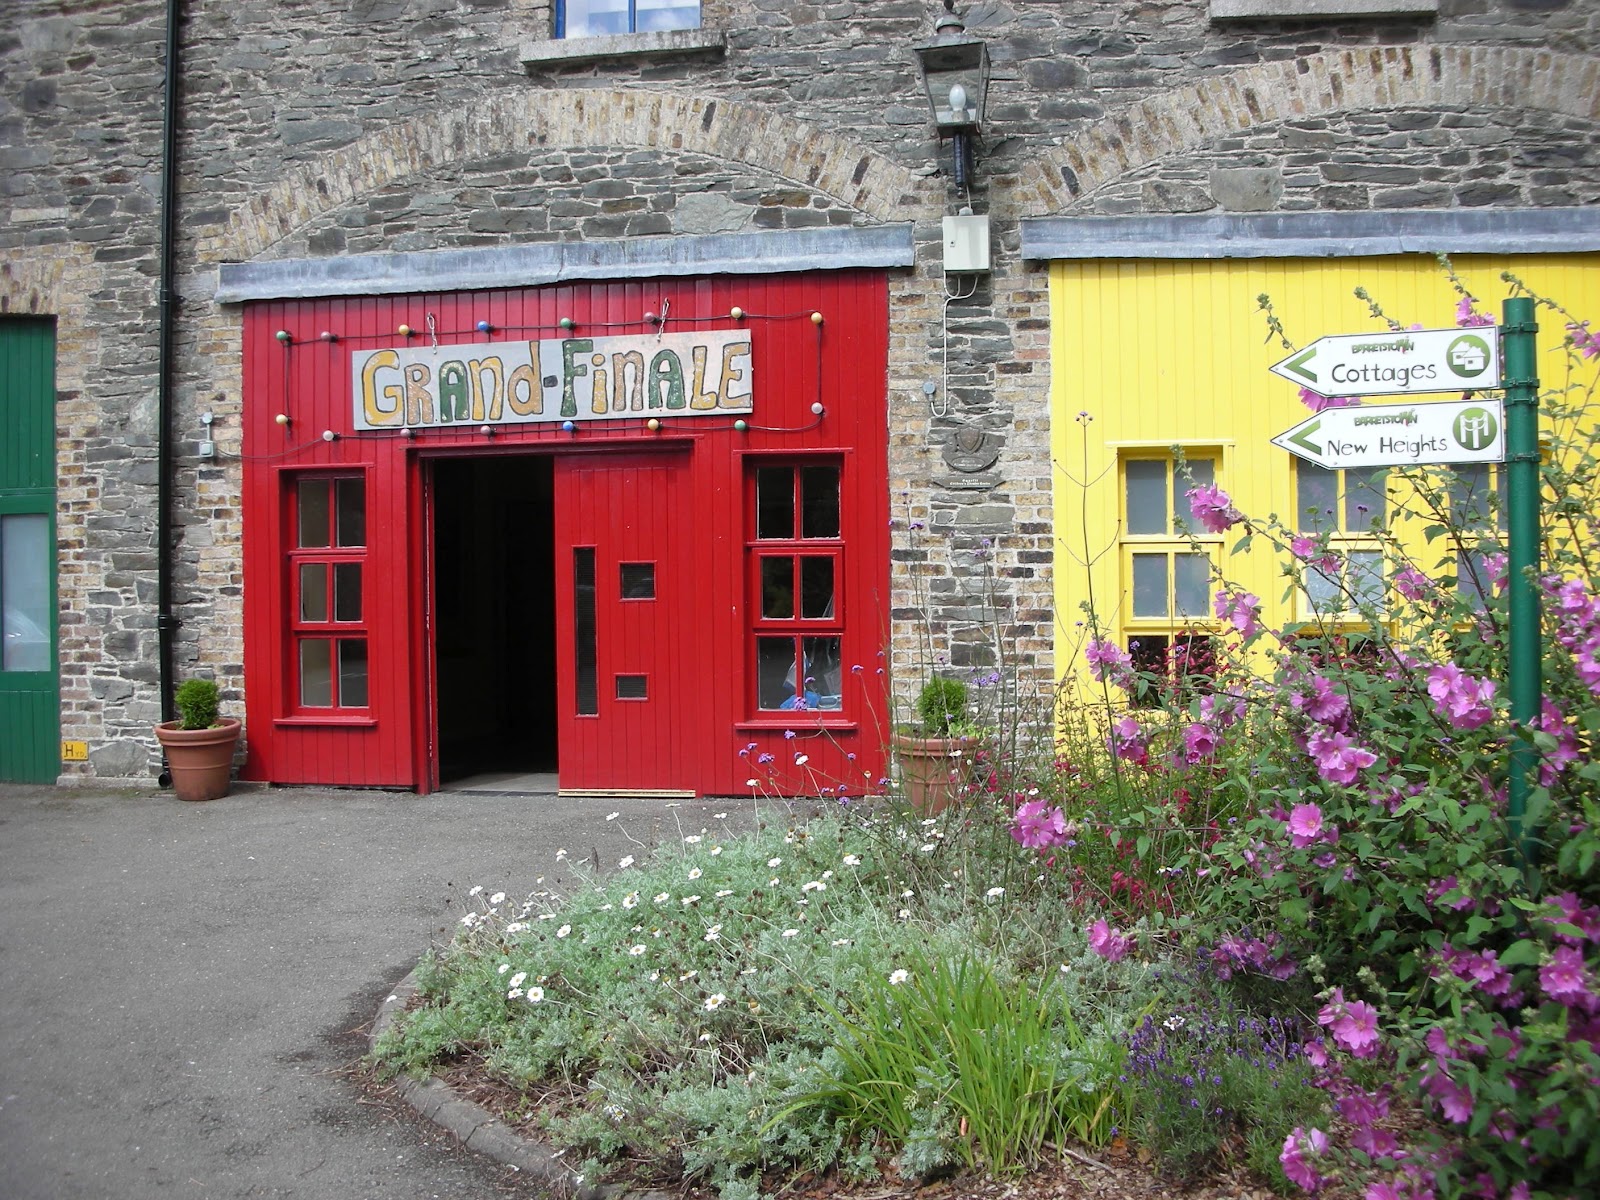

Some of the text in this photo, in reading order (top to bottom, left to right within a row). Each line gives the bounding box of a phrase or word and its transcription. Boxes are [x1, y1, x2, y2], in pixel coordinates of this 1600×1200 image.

[1331, 363, 1437, 387] Cottages
[1327, 434, 1448, 458] New Heights
